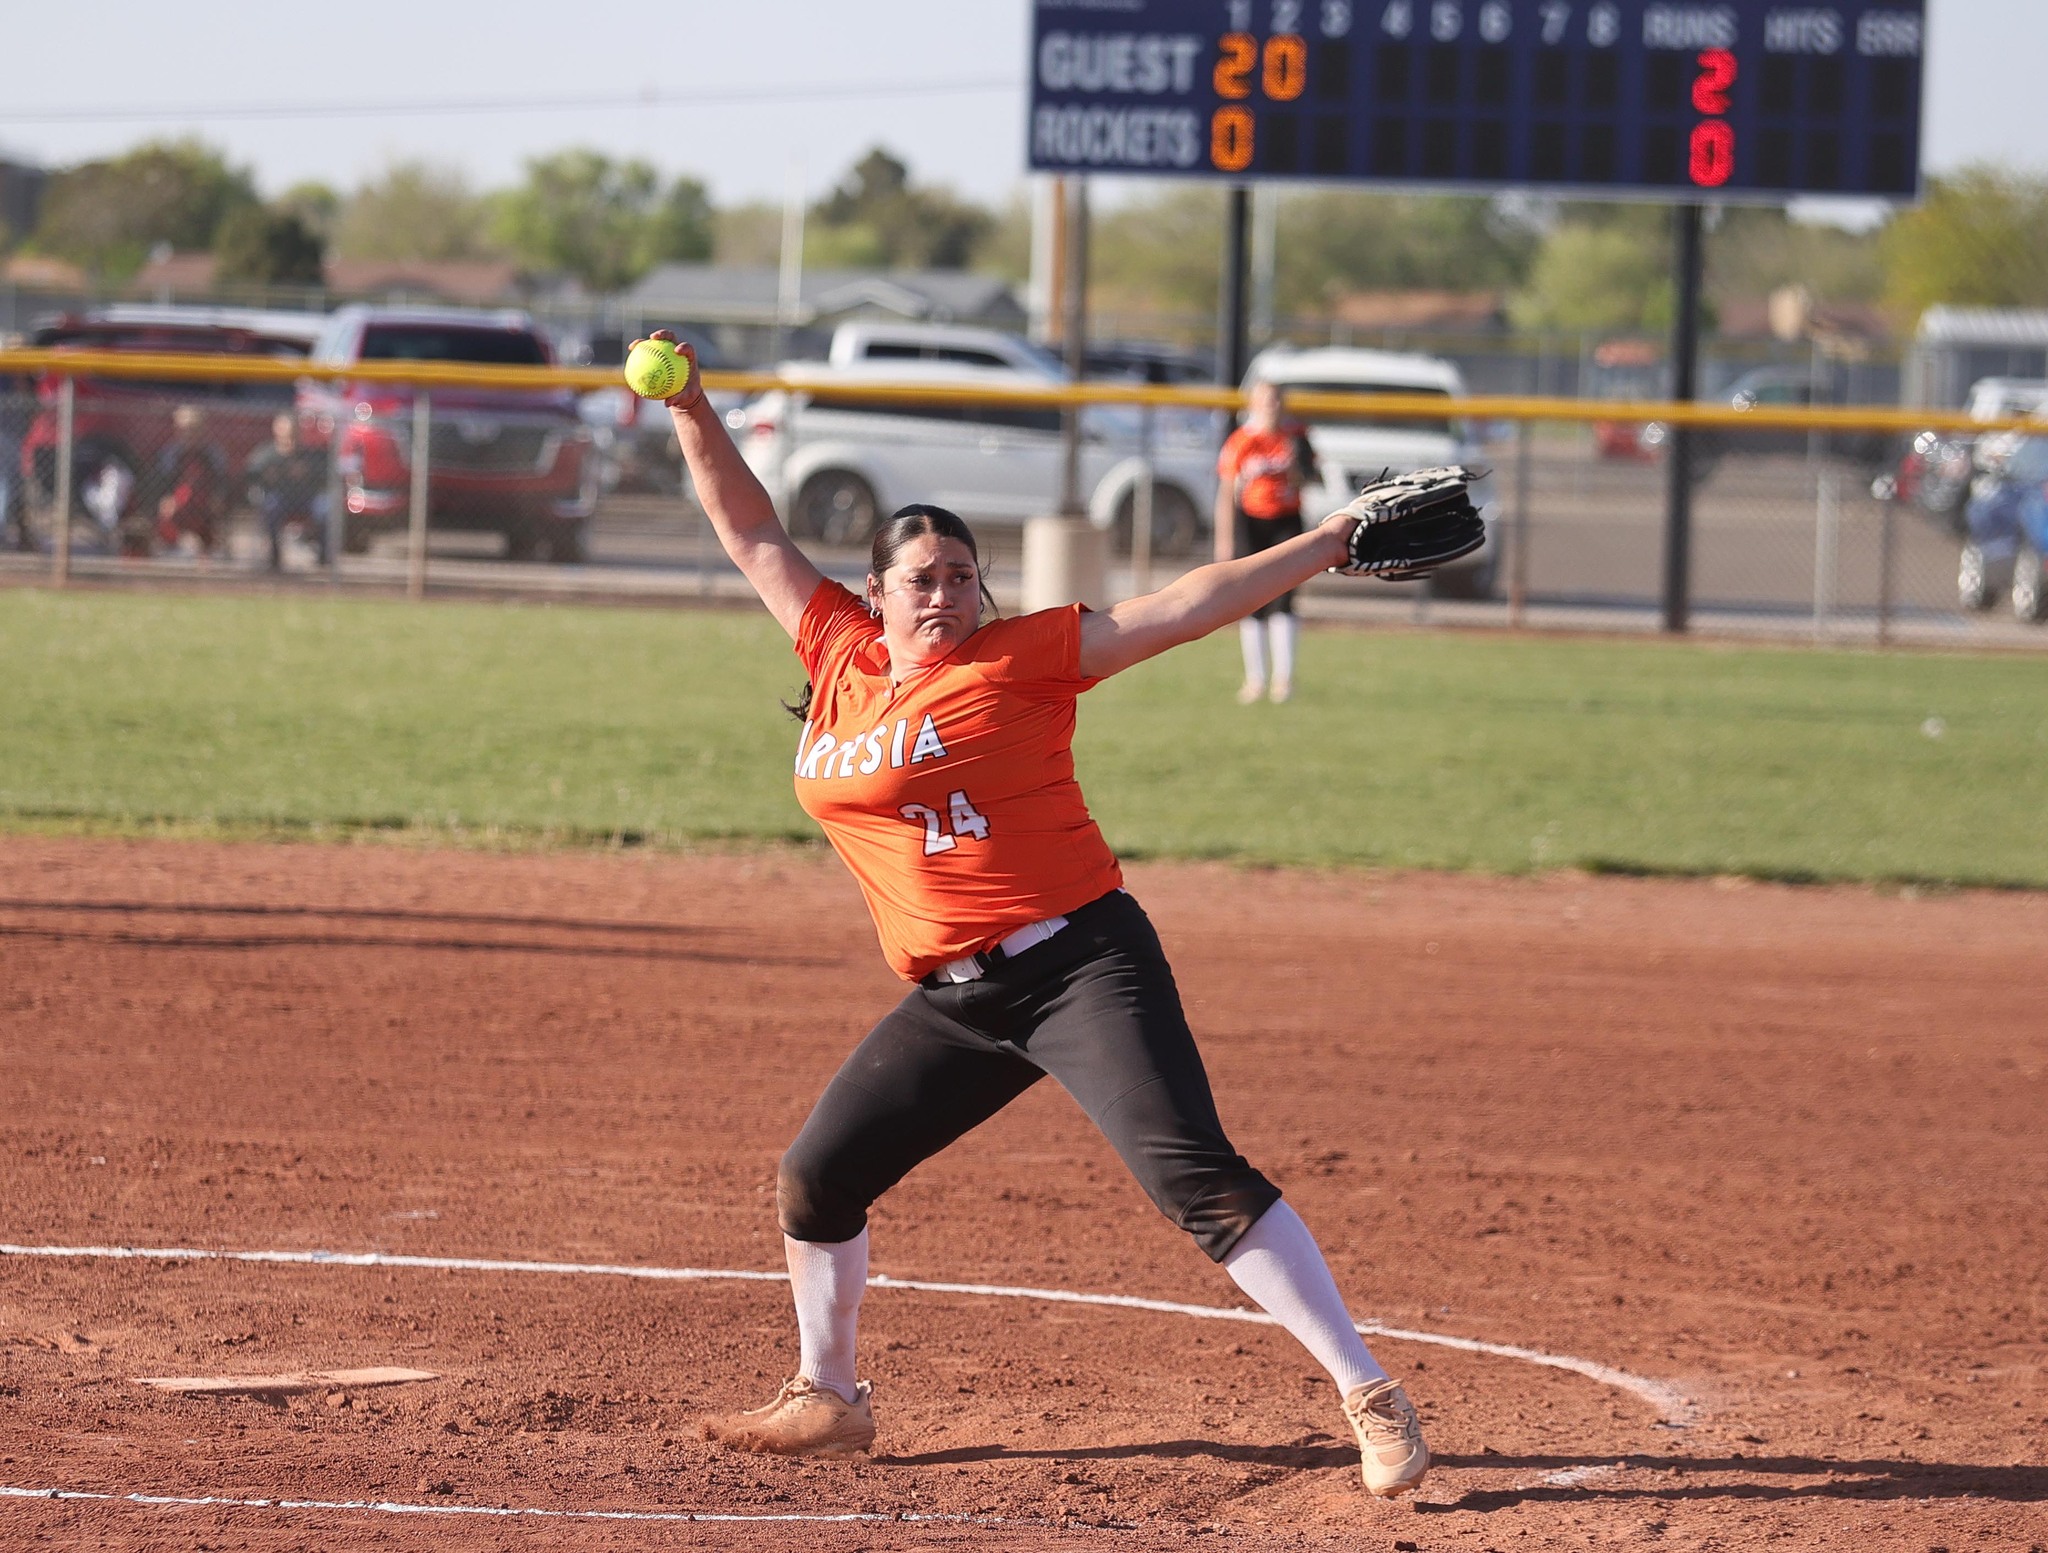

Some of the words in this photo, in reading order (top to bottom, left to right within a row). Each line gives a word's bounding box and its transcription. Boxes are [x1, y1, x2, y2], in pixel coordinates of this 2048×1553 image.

[1225, 0, 1252, 32] 1
[1270, 0, 1299, 34] 2
[1319, 1, 1352, 38] 3
[1381, 3, 1413, 40] 4
[1429, 4, 1463, 42] 5
[1477, 6, 1510, 43] 6
[1537, 5, 1572, 45] 7
[1585, 6, 1620, 48] 8
[1642, 8, 1738, 51] RUNS
[1763, 11, 1844, 54] HITS
[1039, 35, 1199, 94] GUEST
[1691, 47, 1738, 115] 2
[1033, 105, 1201, 168] ROCKETS
[1209, 103, 1255, 172] 0
[1688, 118, 1735, 187] 0
[897, 789, 991, 857] 24
